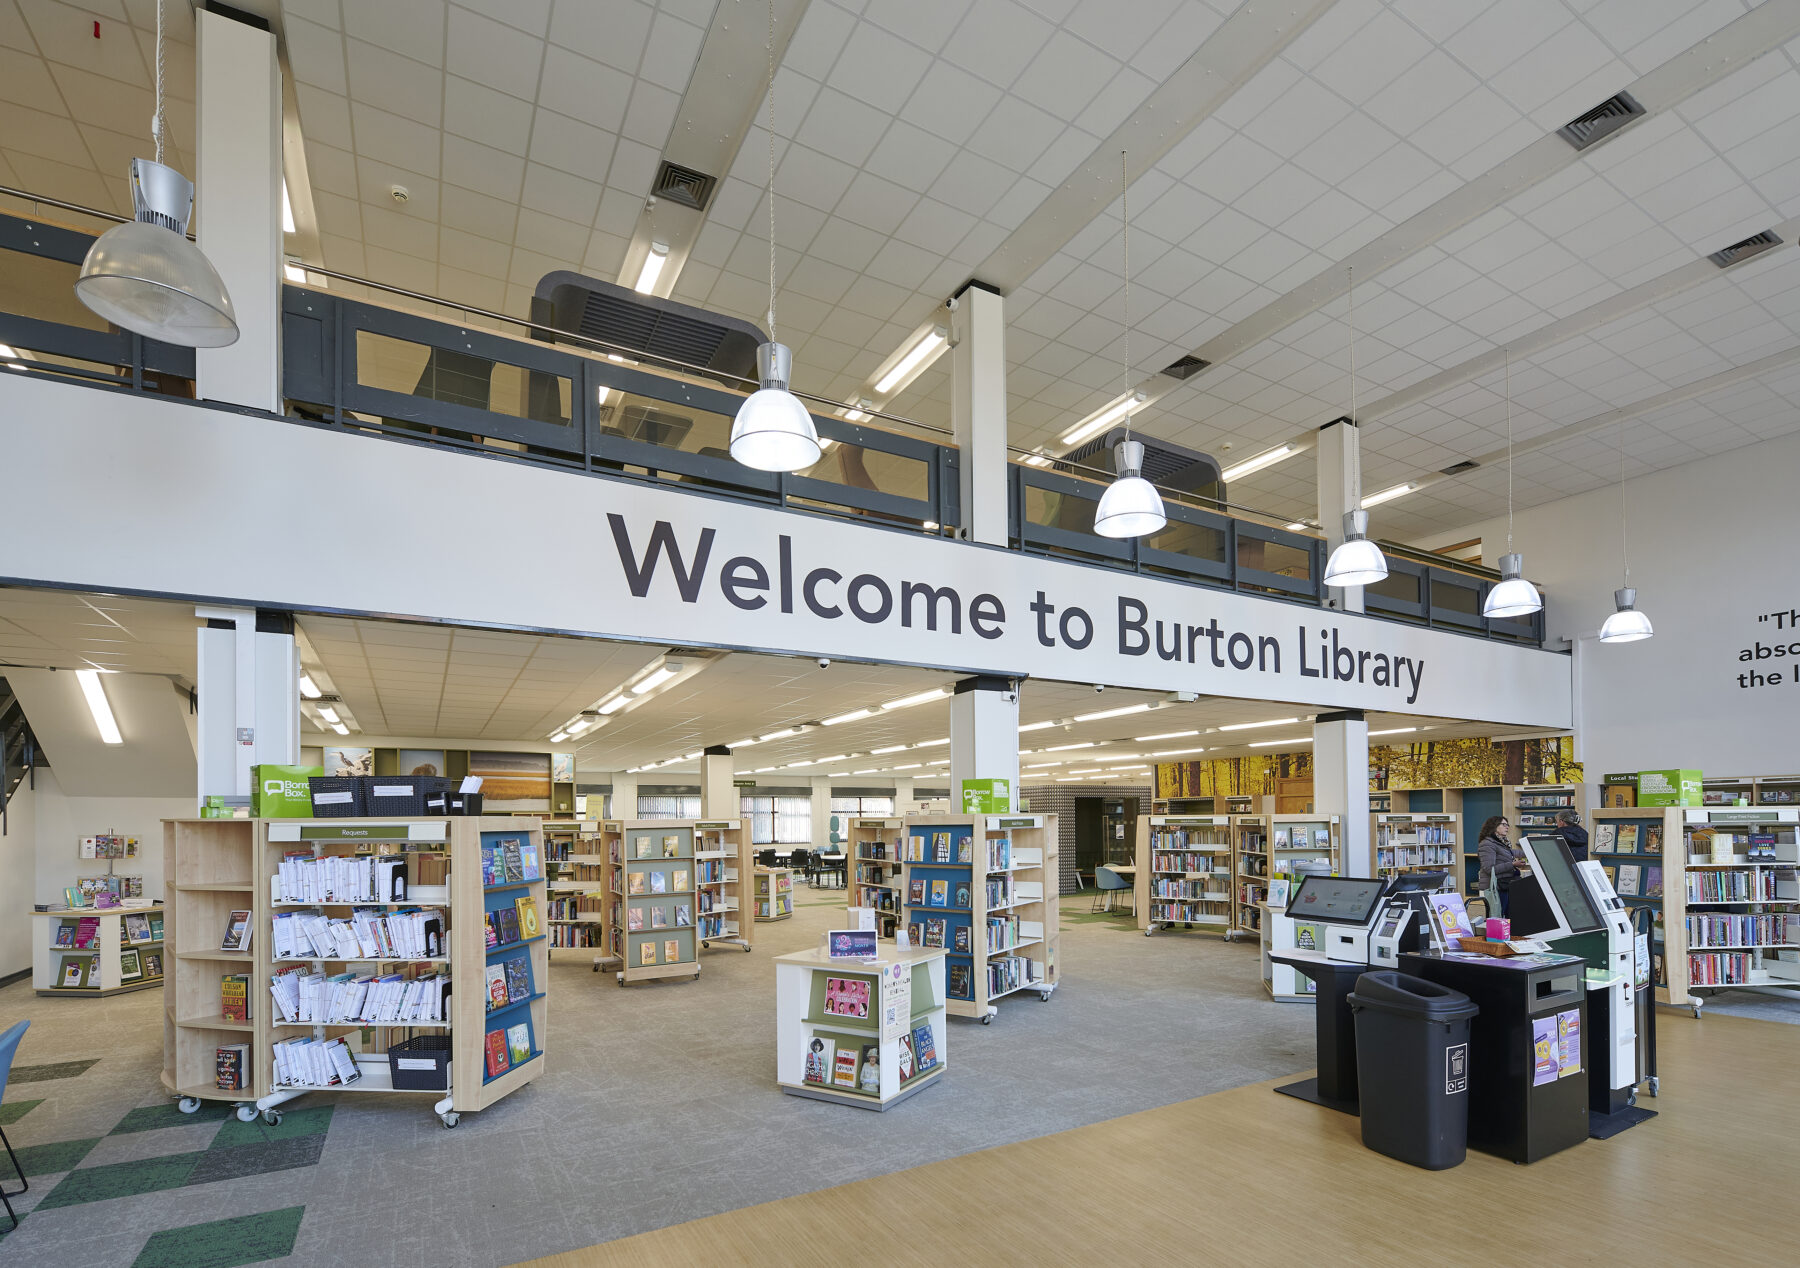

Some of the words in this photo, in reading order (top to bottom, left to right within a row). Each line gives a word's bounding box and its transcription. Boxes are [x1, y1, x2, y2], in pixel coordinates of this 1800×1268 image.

[607, 513, 1003, 639] Welcome
[1030, 591, 1093, 649] to
[1118, 596, 1281, 673] Burton
[1300, 626, 1424, 704] Library
[1737, 669, 1783, 688] the
[285, 781, 310, 789] Borro
[899, 1051, 910, 1059] WISE
